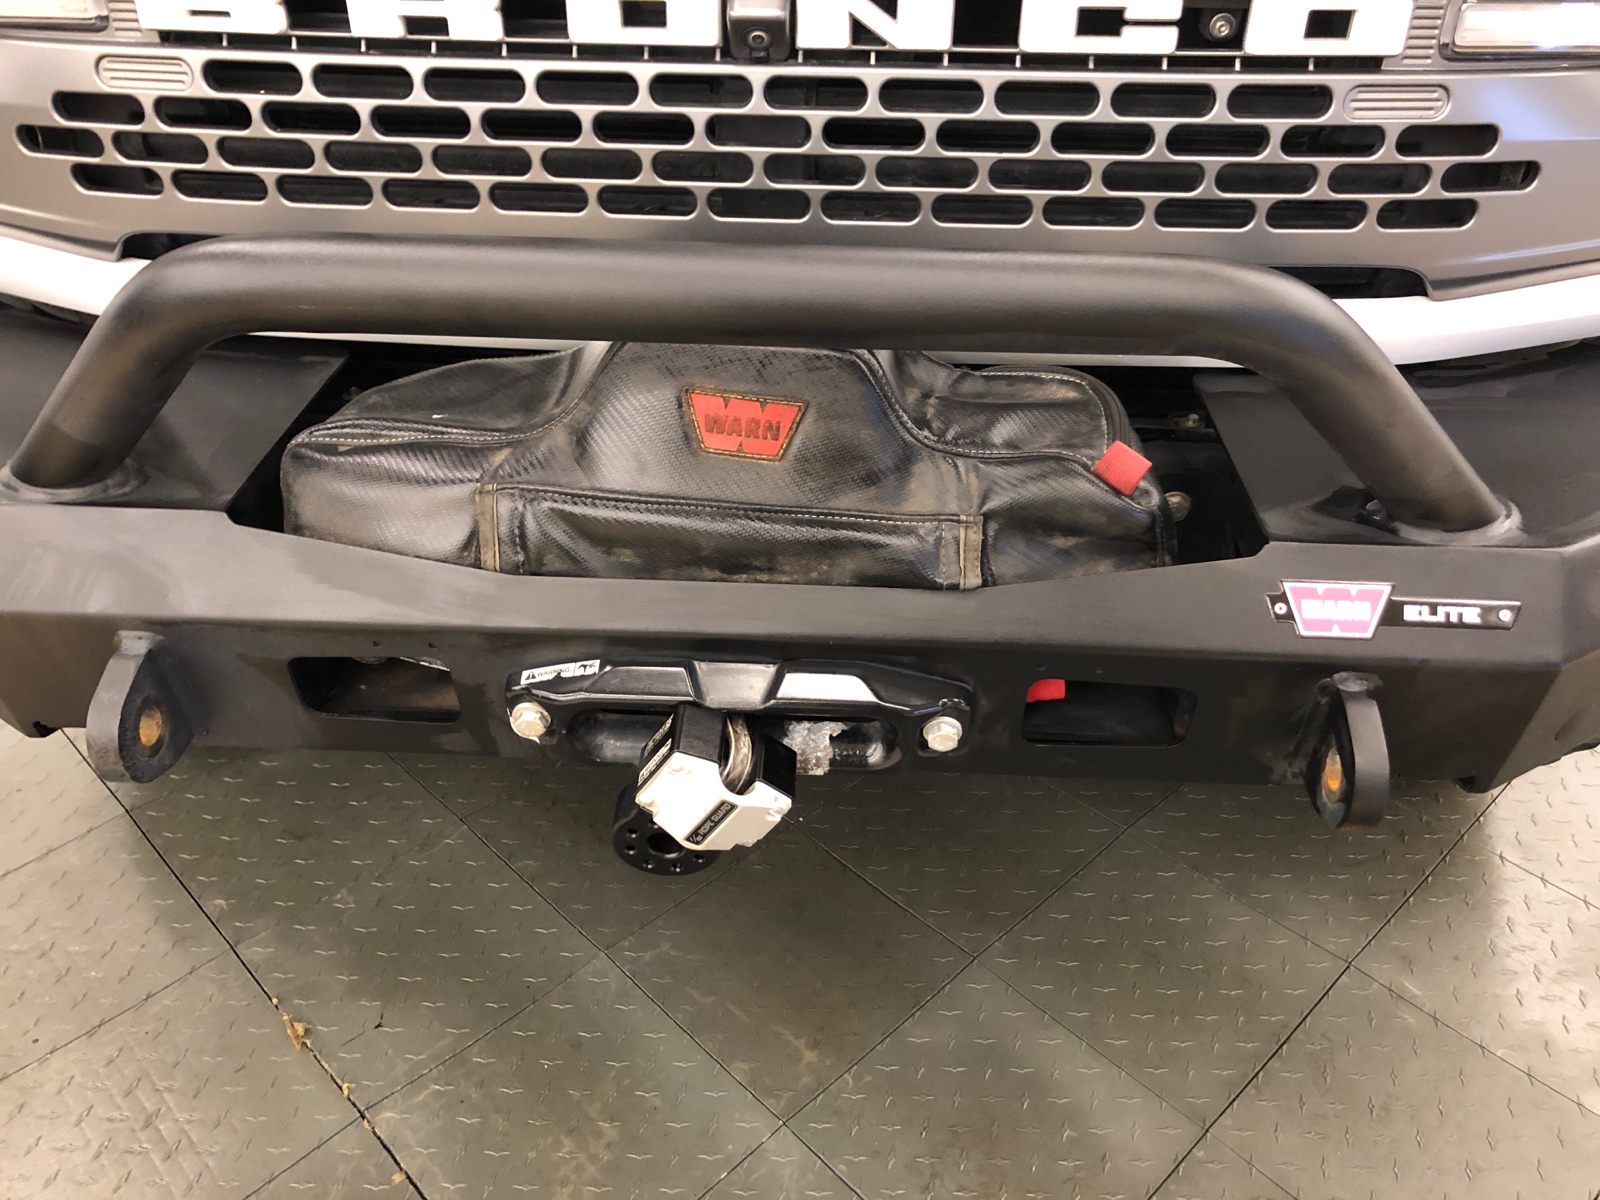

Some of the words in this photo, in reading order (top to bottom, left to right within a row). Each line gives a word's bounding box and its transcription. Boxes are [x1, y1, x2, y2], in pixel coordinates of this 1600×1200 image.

[704, 413, 781, 441] WARN
[1301, 598, 1372, 622] WARN
[1403, 604, 1482, 624] ELITE
[537, 667, 570, 677] WARNING
[697, 820, 715, 835] ROPE
[711, 803, 731, 821] GUARD
